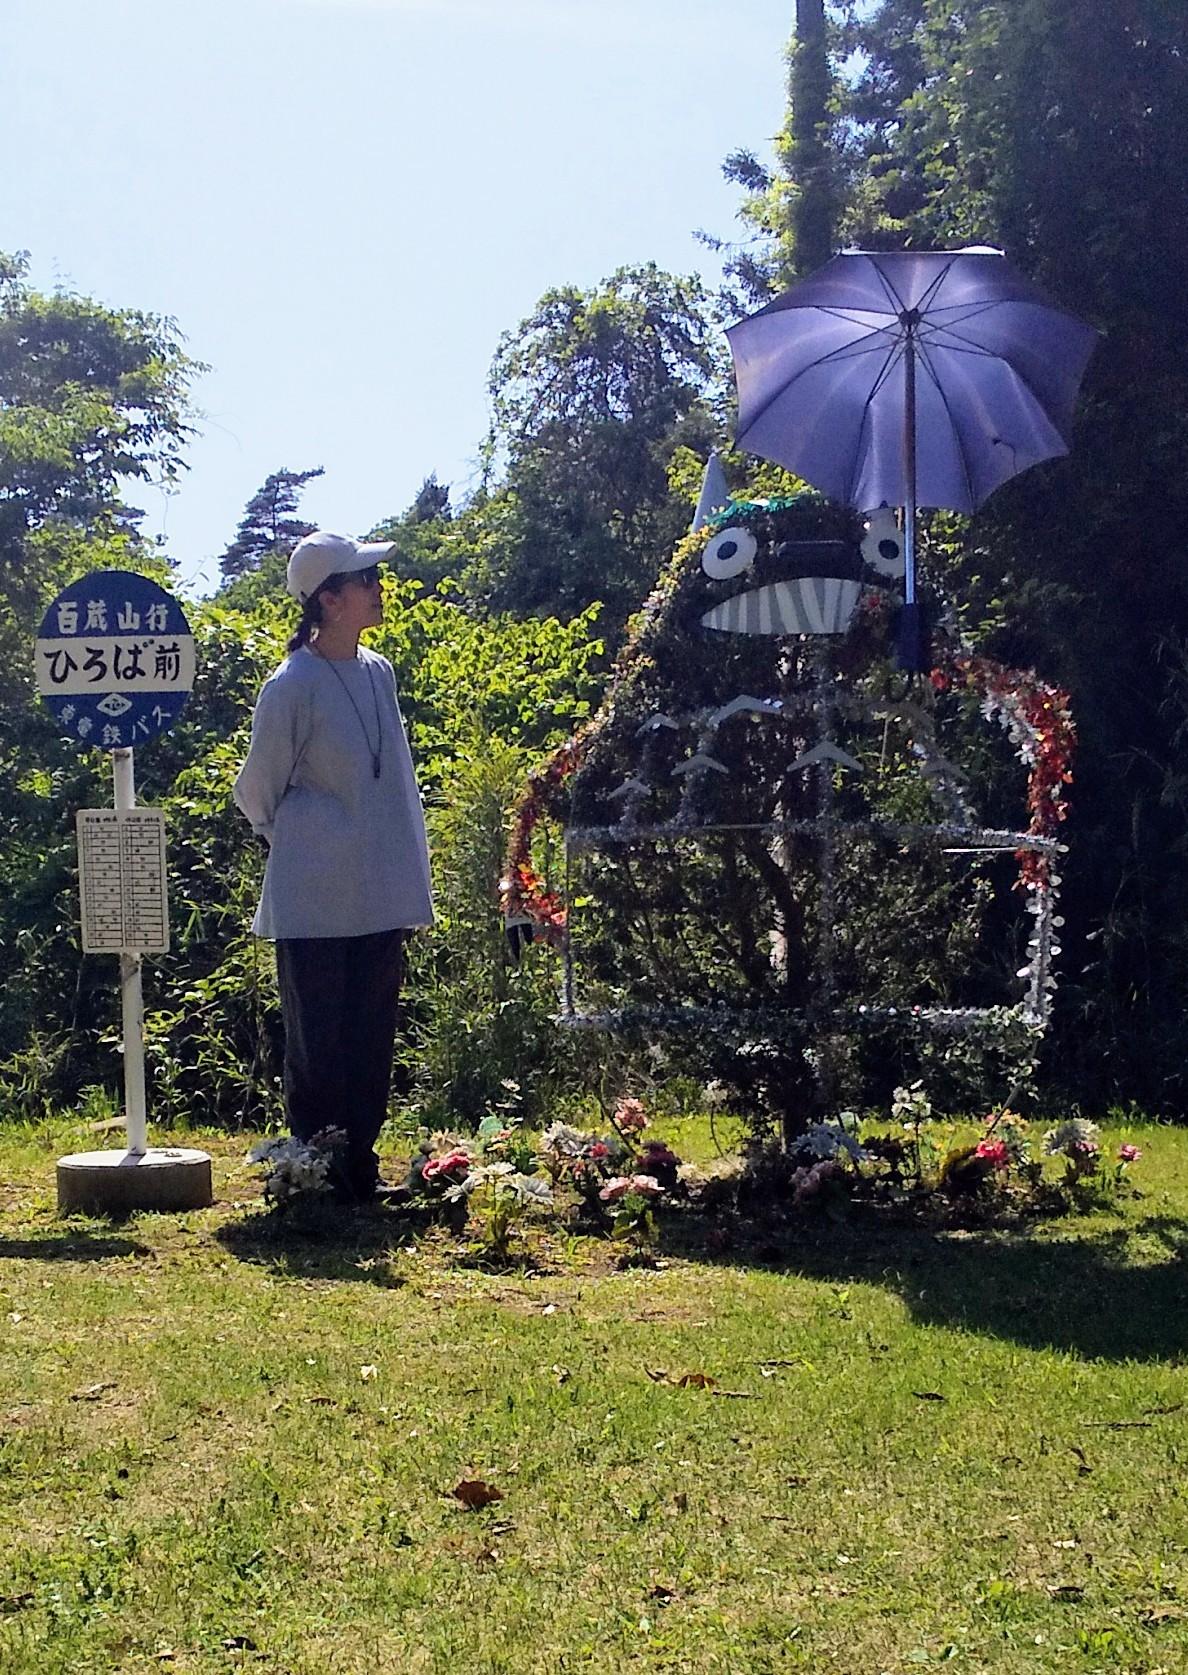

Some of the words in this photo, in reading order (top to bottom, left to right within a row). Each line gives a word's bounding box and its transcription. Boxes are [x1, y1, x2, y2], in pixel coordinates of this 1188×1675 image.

[57, 599, 169, 635] 百蔵山行
[43, 639, 181, 684] ひろば前
